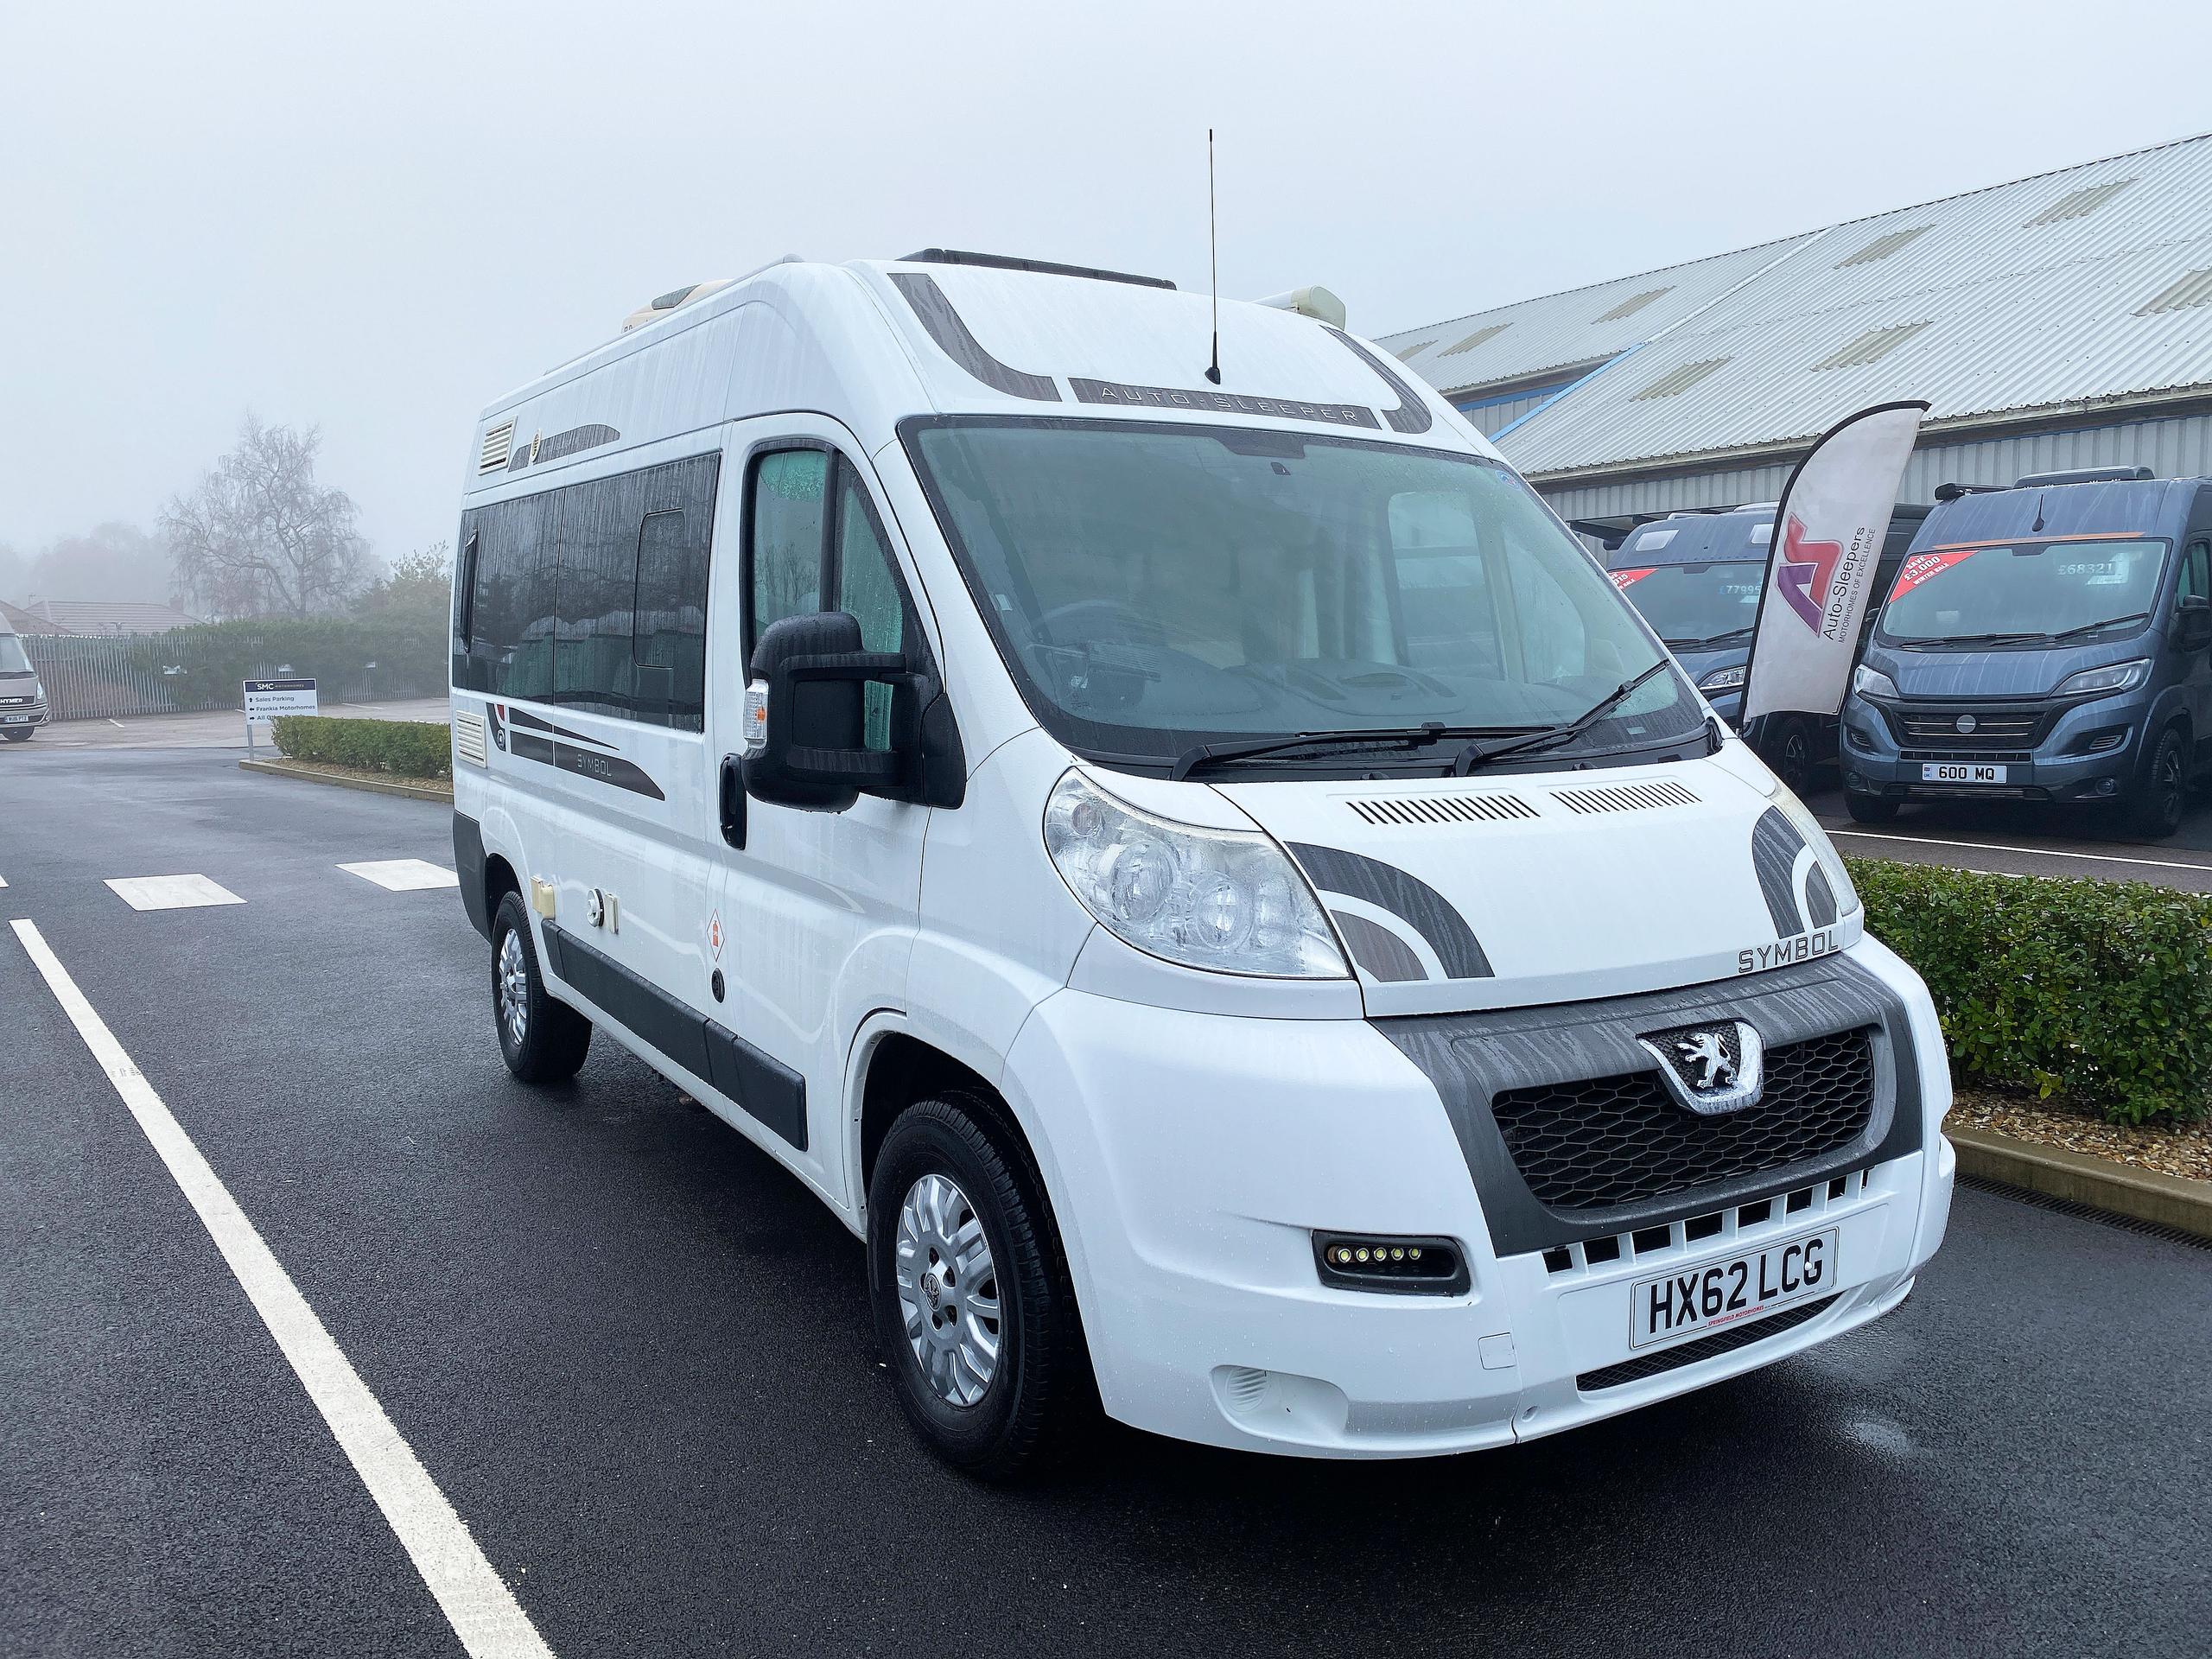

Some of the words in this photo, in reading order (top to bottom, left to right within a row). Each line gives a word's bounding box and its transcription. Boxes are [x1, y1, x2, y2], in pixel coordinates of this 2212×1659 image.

[1904, 556, 1941, 581] £3,000
[1906, 556, 1927, 569] SAVE
[1912, 570, 1936, 585] WINTER
[1935, 562, 1949, 573] SALE
[2057, 563, 2113, 575] £68321
[1822, 526, 1865, 640] Auto-Sleepers
[1838, 590, 1858, 644] MOTORHOMES
[1853, 578, 1861, 591] OF
[1857, 528, 1876, 578] EXCELLENCE
[576, 753, 613, 777] SYMBOL
[1939, 766, 1967, 779] 600
[1974, 767, 1995, 781] MQ
[1738, 930, 1839, 974] SYMBOL
[1649, 1261, 1749, 1334] HX62
[1758, 1237, 1825, 1302] LCG
[1707, 1313, 1735, 1327] SPRINGFIELD
[1735, 1305, 1764, 1319] MOTORHOMES
